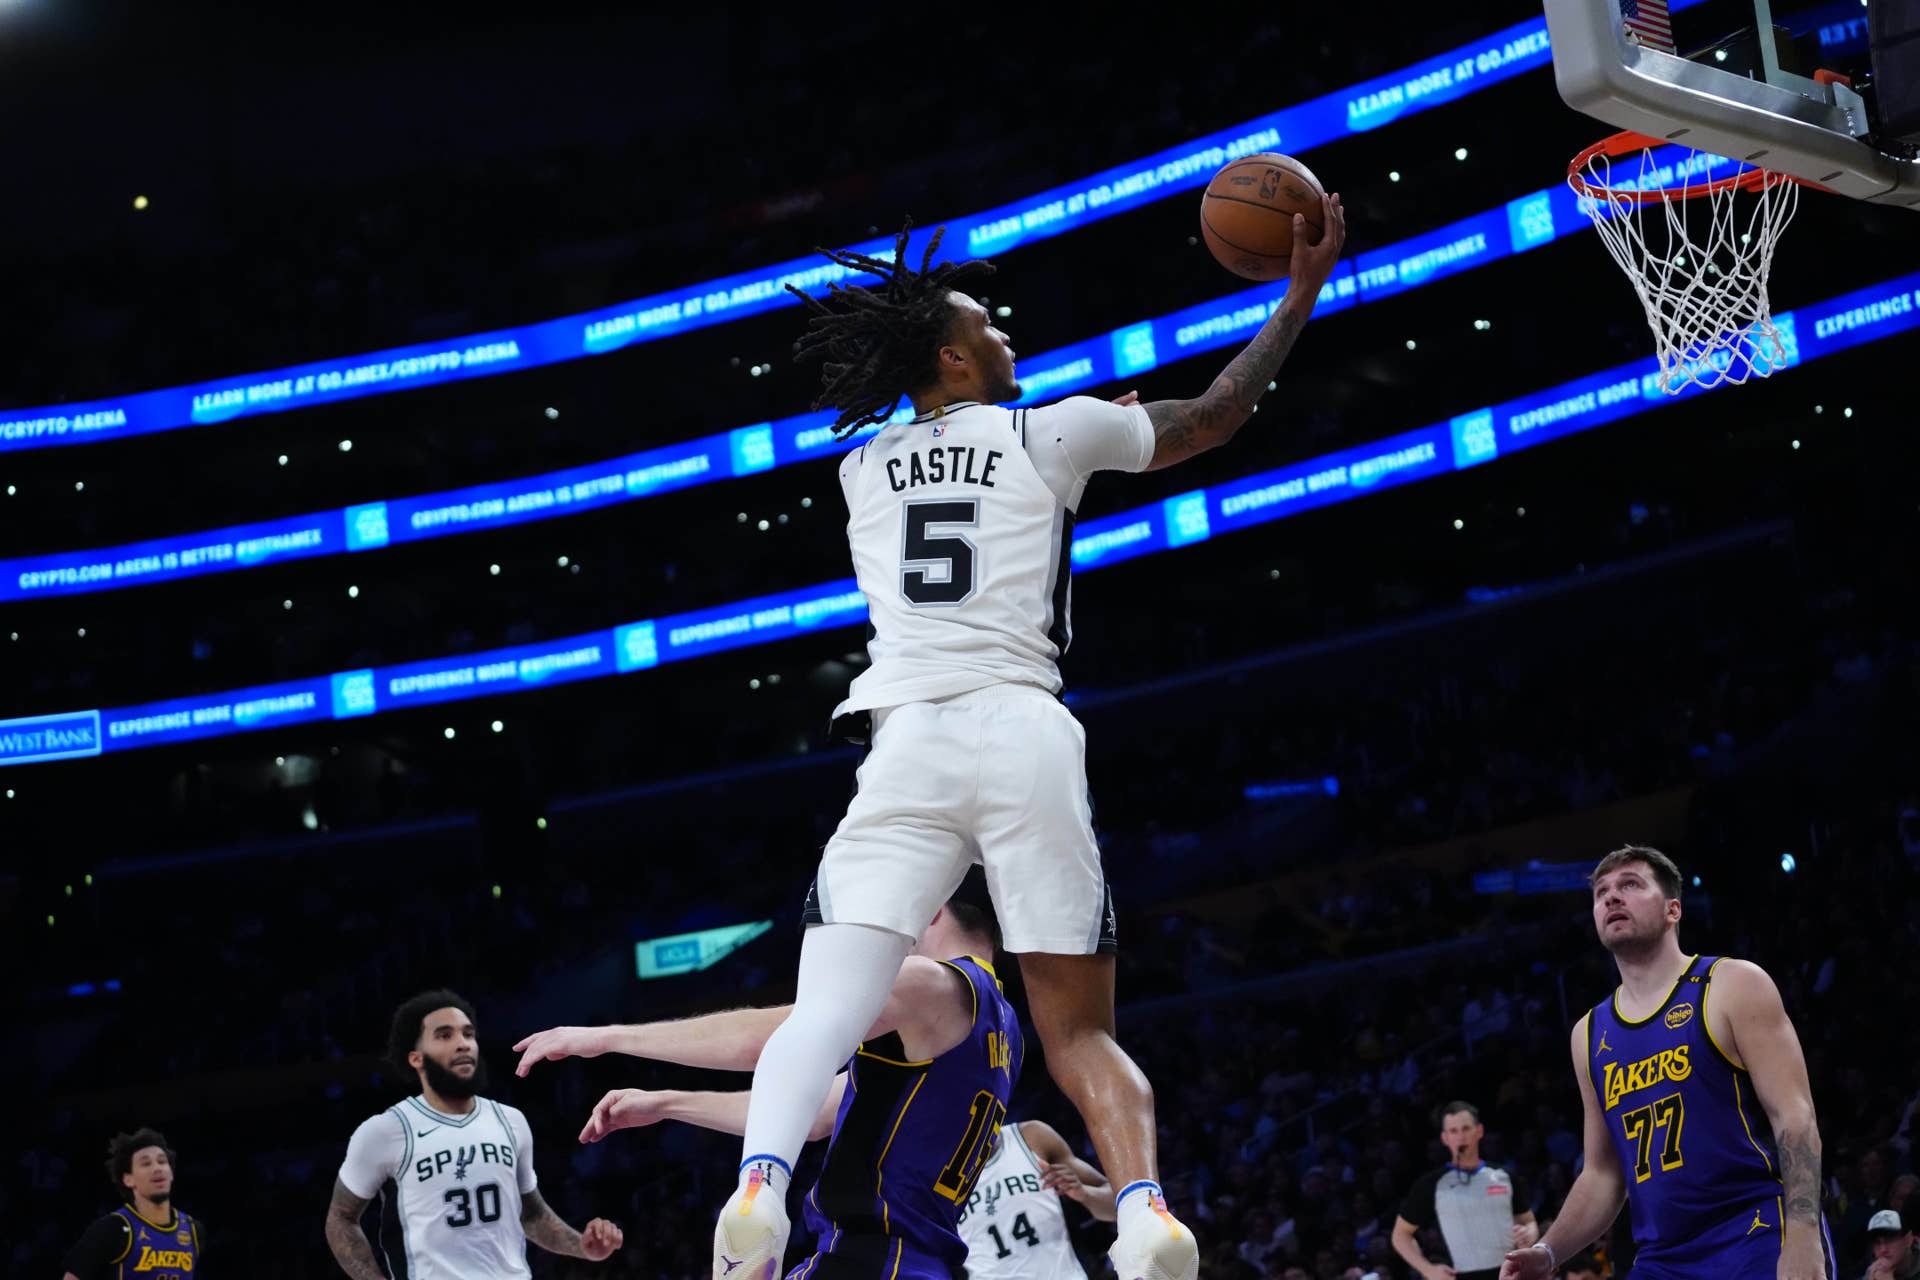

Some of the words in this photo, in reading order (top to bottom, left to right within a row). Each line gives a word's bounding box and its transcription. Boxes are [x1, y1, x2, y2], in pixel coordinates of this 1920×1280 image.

[1348, 86, 1404, 118] LEARN
[1405, 68, 1453, 98] MORE
[1454, 58, 1475, 81] AT
[1475, 29, 1552, 73] GO.AMEX
[969, 216, 1021, 244] LEARN
[1023, 199, 1066, 228] MORE
[1067, 190, 1087, 213] AT
[585, 314, 636, 340] LEARN
[637, 302, 681, 328] MORE
[683, 296, 704, 317] AT
[1815, 293, 1913, 339] EXPERIENCE
[193, 388, 244, 411] LEARN
[247, 379, 293, 403] MORE
[295, 375, 314, 394] AT
[1510, 393, 1596, 435] EXPERIENCE
[1598, 377, 1640, 405] MORE
[886, 446, 1003, 492] CASTLE
[1222, 478, 1306, 517] EXPERIENCE
[1308, 466, 1348, 493] MORE
[411, 499, 505, 529] CRYPTO.COM
[507, 490, 555, 513] ARENA
[556, 486, 571, 503] IS
[573, 474, 625, 500] BETTER
[19, 564, 113, 589] CRYPTO.COM
[115, 556, 161, 578] ARENA
[163, 553, 179, 569] IS
[180, 543, 233, 566] BETTER
[899, 497, 981, 608] 5
[390, 667, 475, 696] EXPERIENCE
[476, 660, 517, 681] MORE
[109, 710, 191, 738] EXPERIENCE
[193, 704, 231, 725] MORE
[1603, 1044, 1692, 1112] LAKERS
[1621, 1092, 1685, 1185] 77
[416, 1142, 514, 1182] SPURS
[444, 1183, 502, 1228] 30
[133, 1246, 194, 1272] LAKERS
[988, 1212, 1041, 1260] 14
